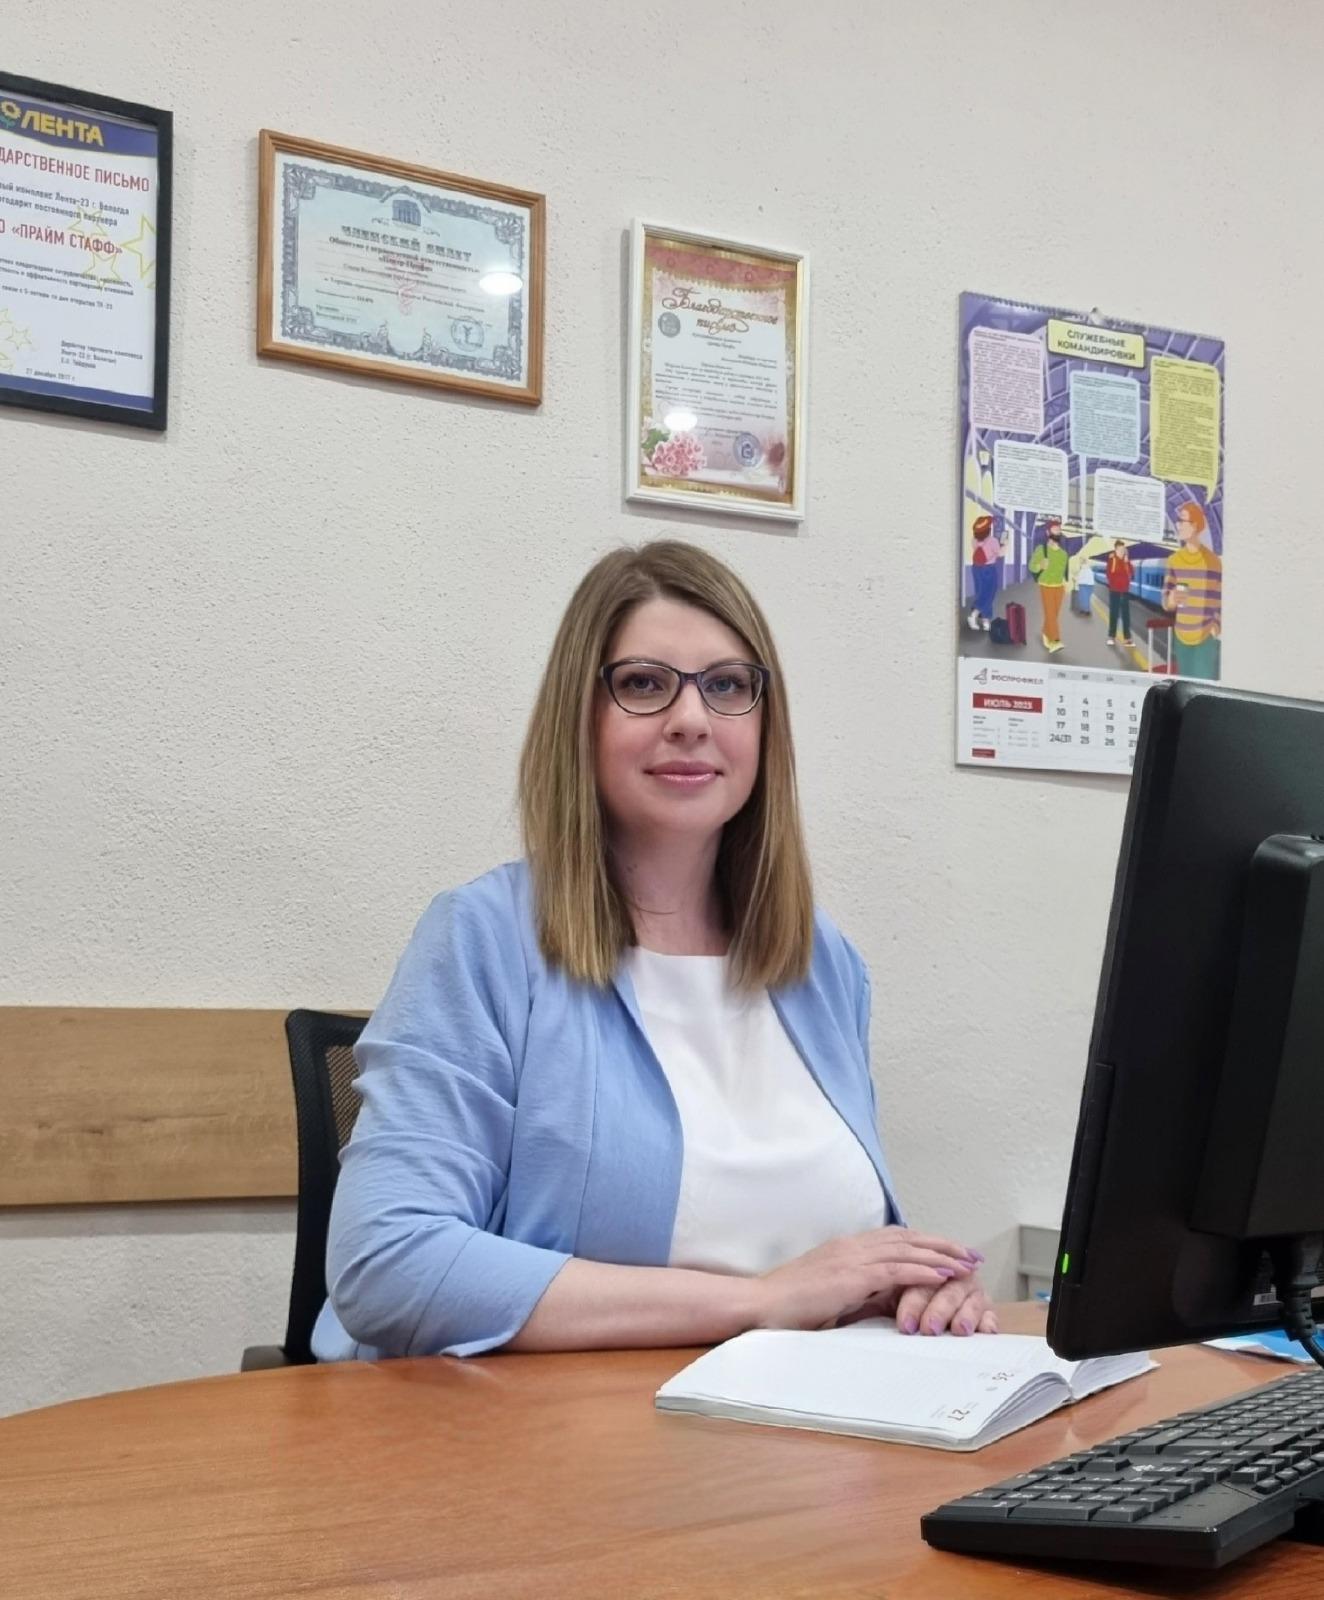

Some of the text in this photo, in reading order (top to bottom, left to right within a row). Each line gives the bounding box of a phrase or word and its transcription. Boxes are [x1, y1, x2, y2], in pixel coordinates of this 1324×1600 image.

[20, 110, 104, 147] ЛЕНТА
[94, 168, 150, 192] ПИСЬМО
[34, 203, 81, 219] постоянного
[83, 212, 118, 227] партнера
[99, 201, 130, 216] Вологда
[12, 223, 65, 246] «ПРАЙМ
[69, 232, 123, 255] СТАФФ»
[341, 225, 472, 263] ЧЛЕНСКИЙ БИЛЕТ
[1066, 329, 1126, 348] СЛУЖЕБНЫЕ
[1056, 340, 1136, 361] КОМАНДИРОВКИ
[991, 674, 1044, 685] РОСПРОФЖЕЛ
[983, 698, 1012, 708] ИЮЛЬ
[1058, 695, 1065, 704] 3
[1082, 697, 1090, 706] 4
[1106, 698, 1113, 708] 5
[1056, 707, 1067, 717] 10
[1056, 720, 1067, 730] 17
[946, 1408, 971, 1422] 27
